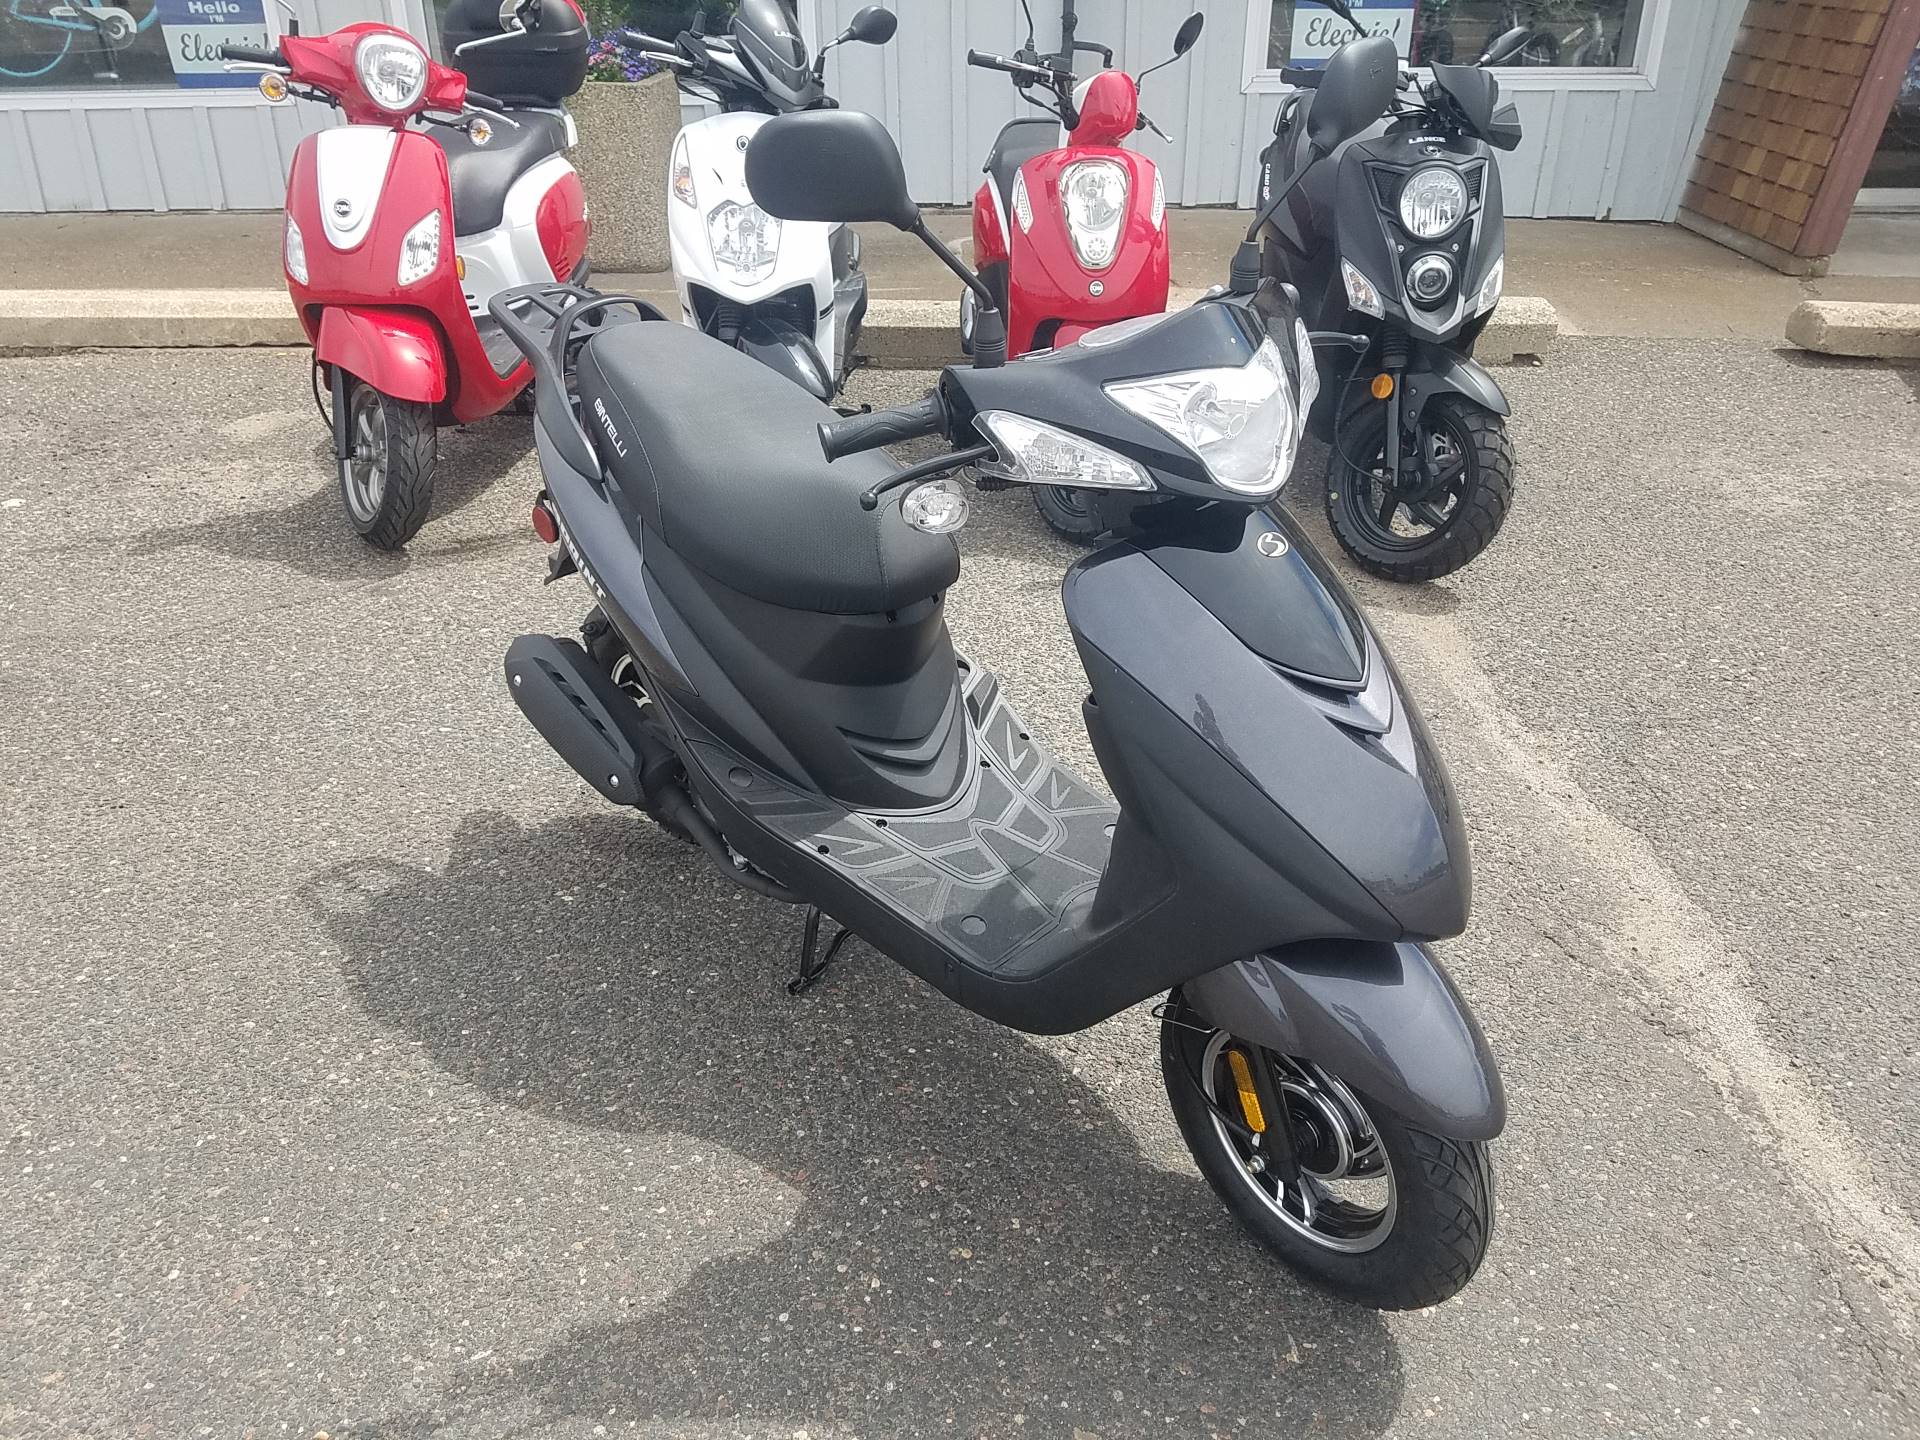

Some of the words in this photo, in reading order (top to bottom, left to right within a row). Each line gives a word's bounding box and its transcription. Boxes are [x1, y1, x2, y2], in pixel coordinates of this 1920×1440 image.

[187, 0, 240, 14] Hello
[1408, 136, 1447, 145] LANCE
[594, 397, 628, 458] BINTELLI
